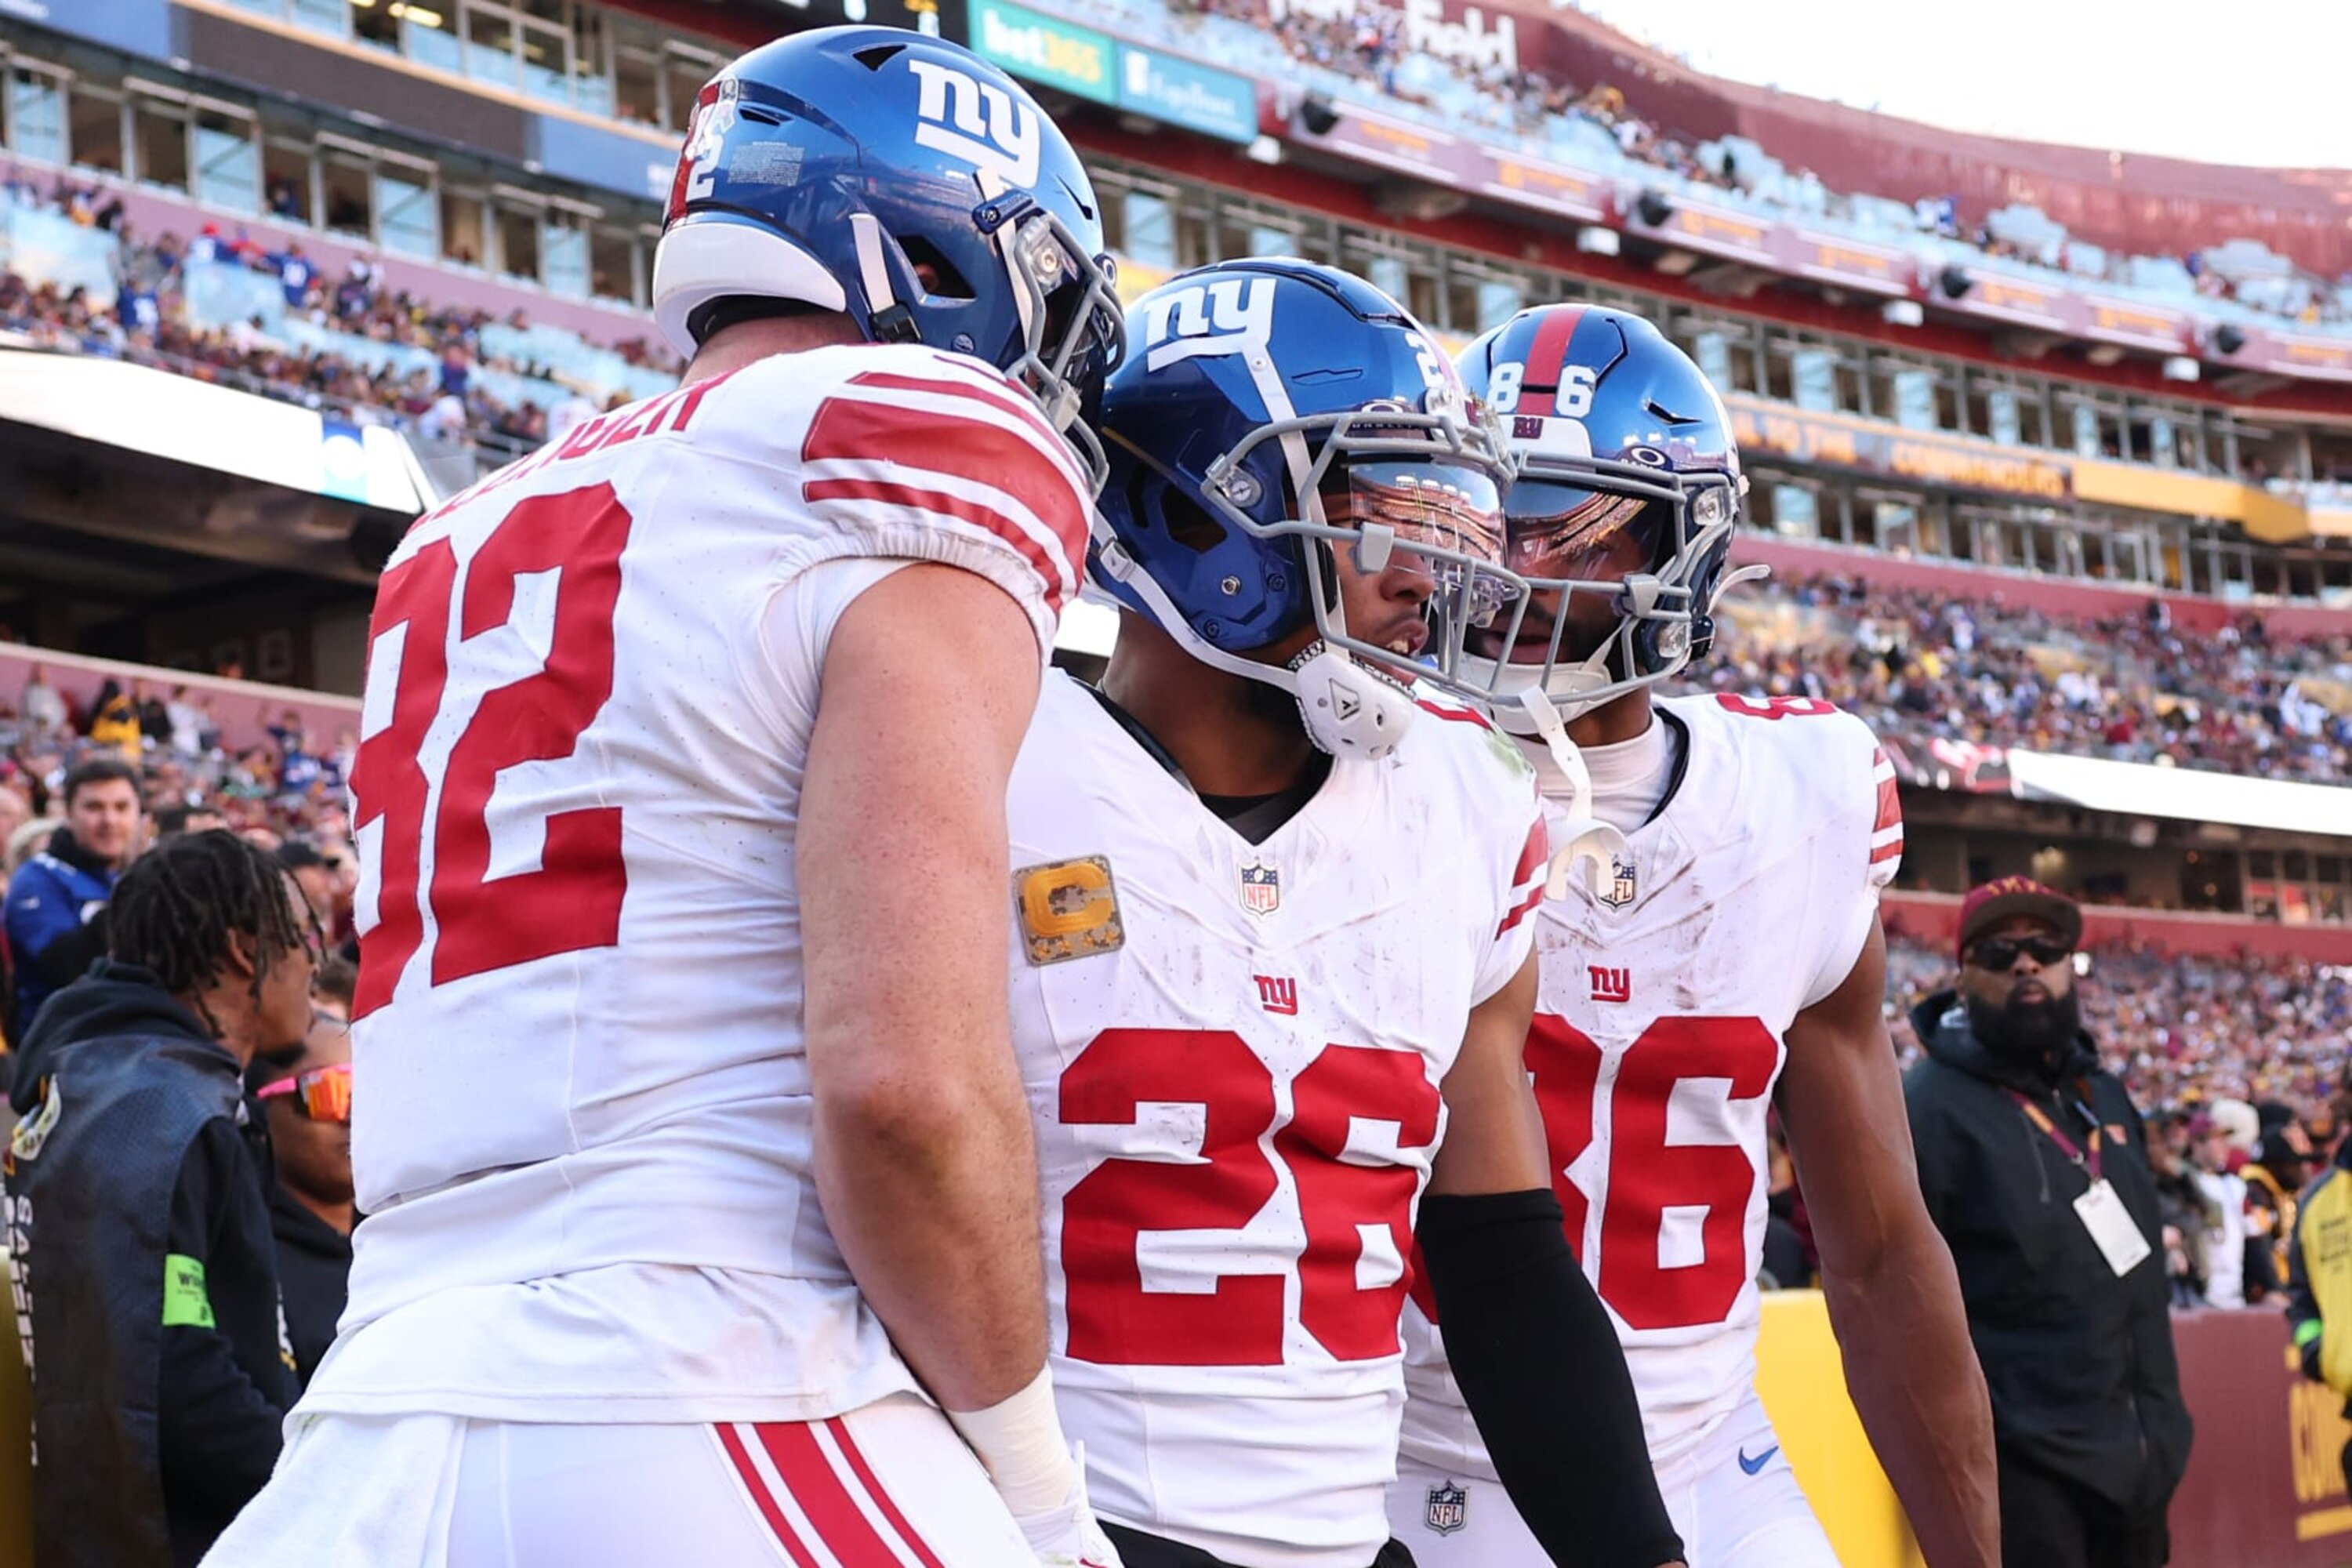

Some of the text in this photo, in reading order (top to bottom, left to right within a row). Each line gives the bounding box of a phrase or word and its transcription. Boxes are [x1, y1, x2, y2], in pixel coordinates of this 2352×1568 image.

[1487, 361, 1597, 419] 86
[1245, 884, 1278, 908] NFL
[1059, 1027, 1442, 1366] 26
[1431, 1504, 1460, 1524] NFL
